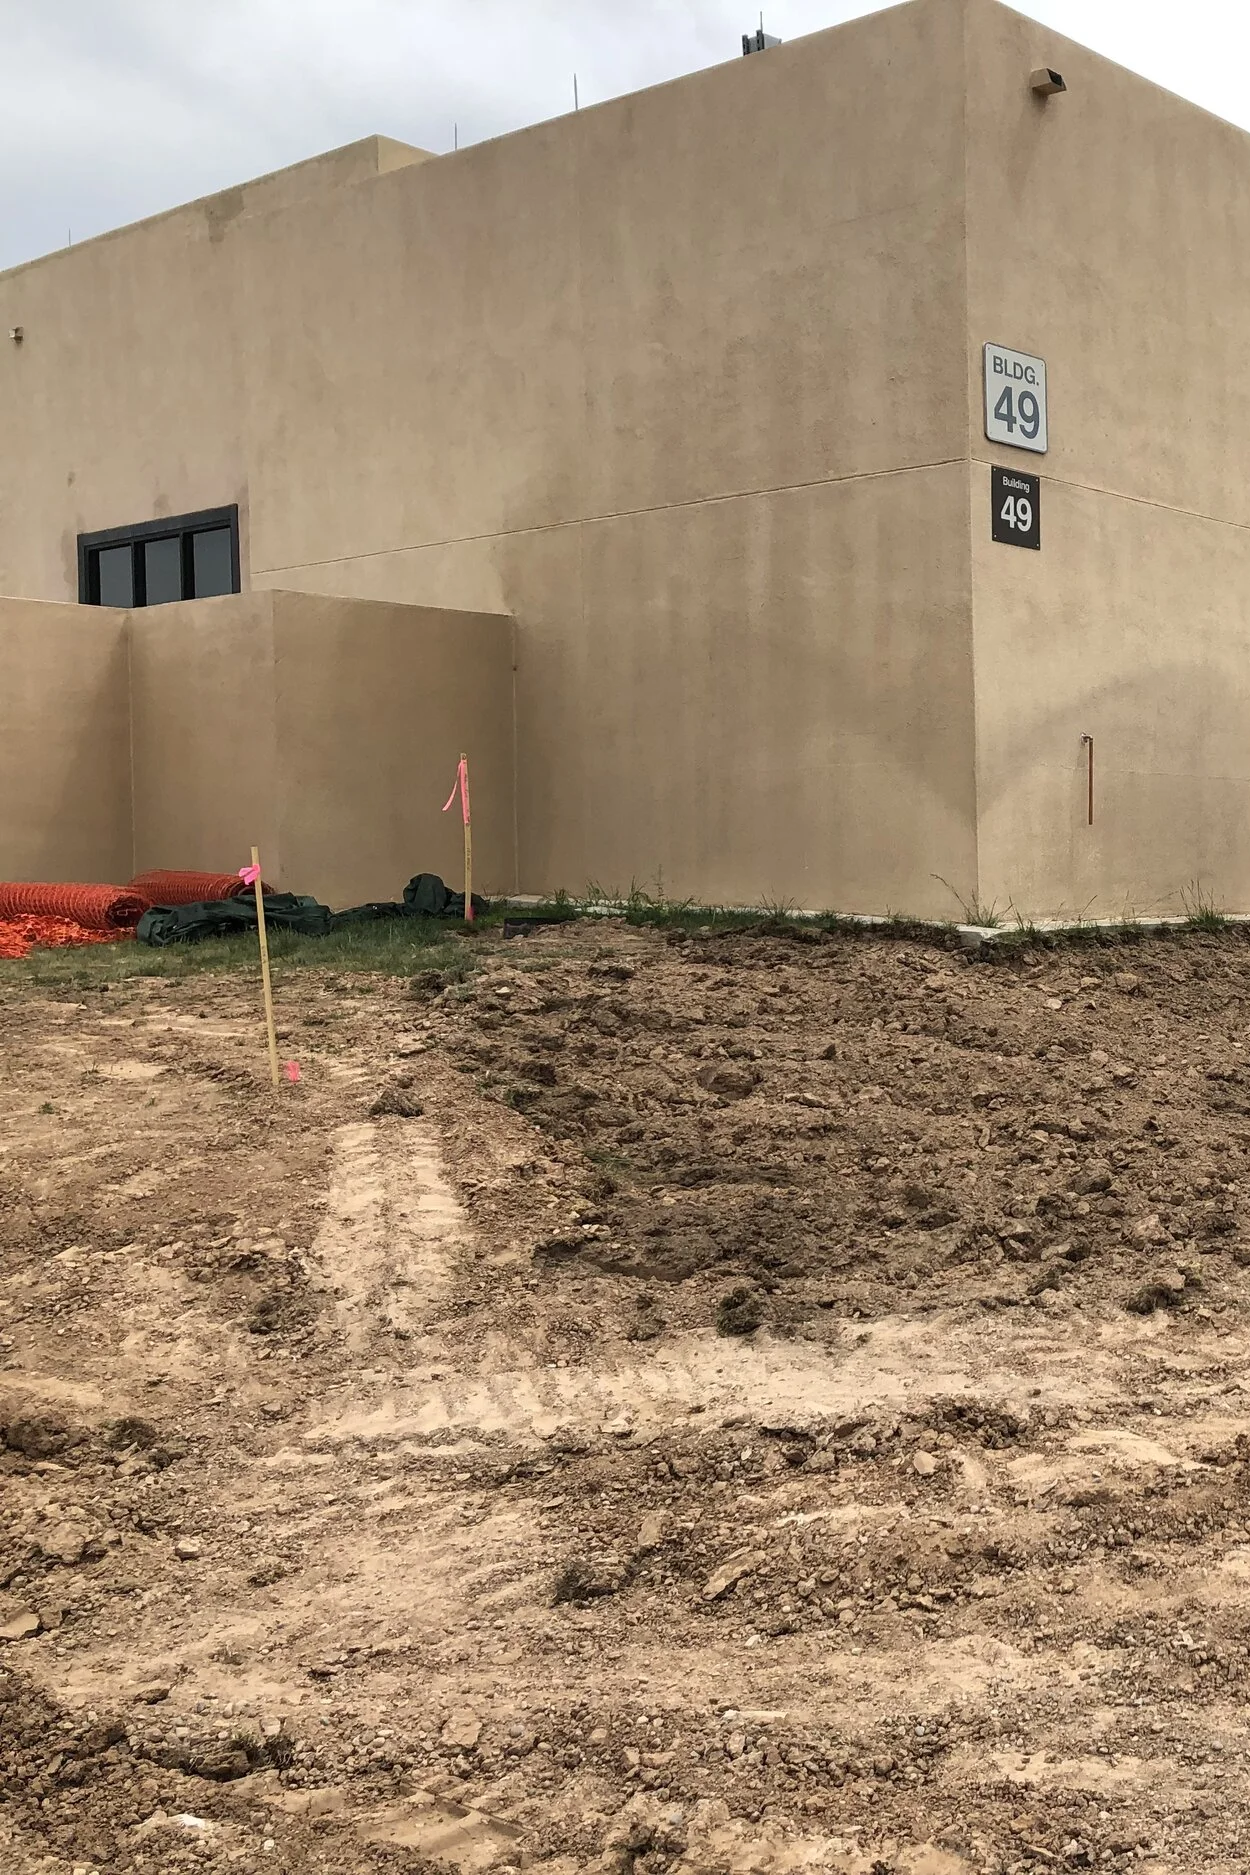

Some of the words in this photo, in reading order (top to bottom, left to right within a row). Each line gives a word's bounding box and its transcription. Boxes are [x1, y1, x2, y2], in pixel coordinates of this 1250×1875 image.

[992, 355, 1039, 386] BLDG.
[994, 385, 1040, 439] 49
[1002, 475, 1030, 494] Building
[1000, 495, 1032, 532] 49
